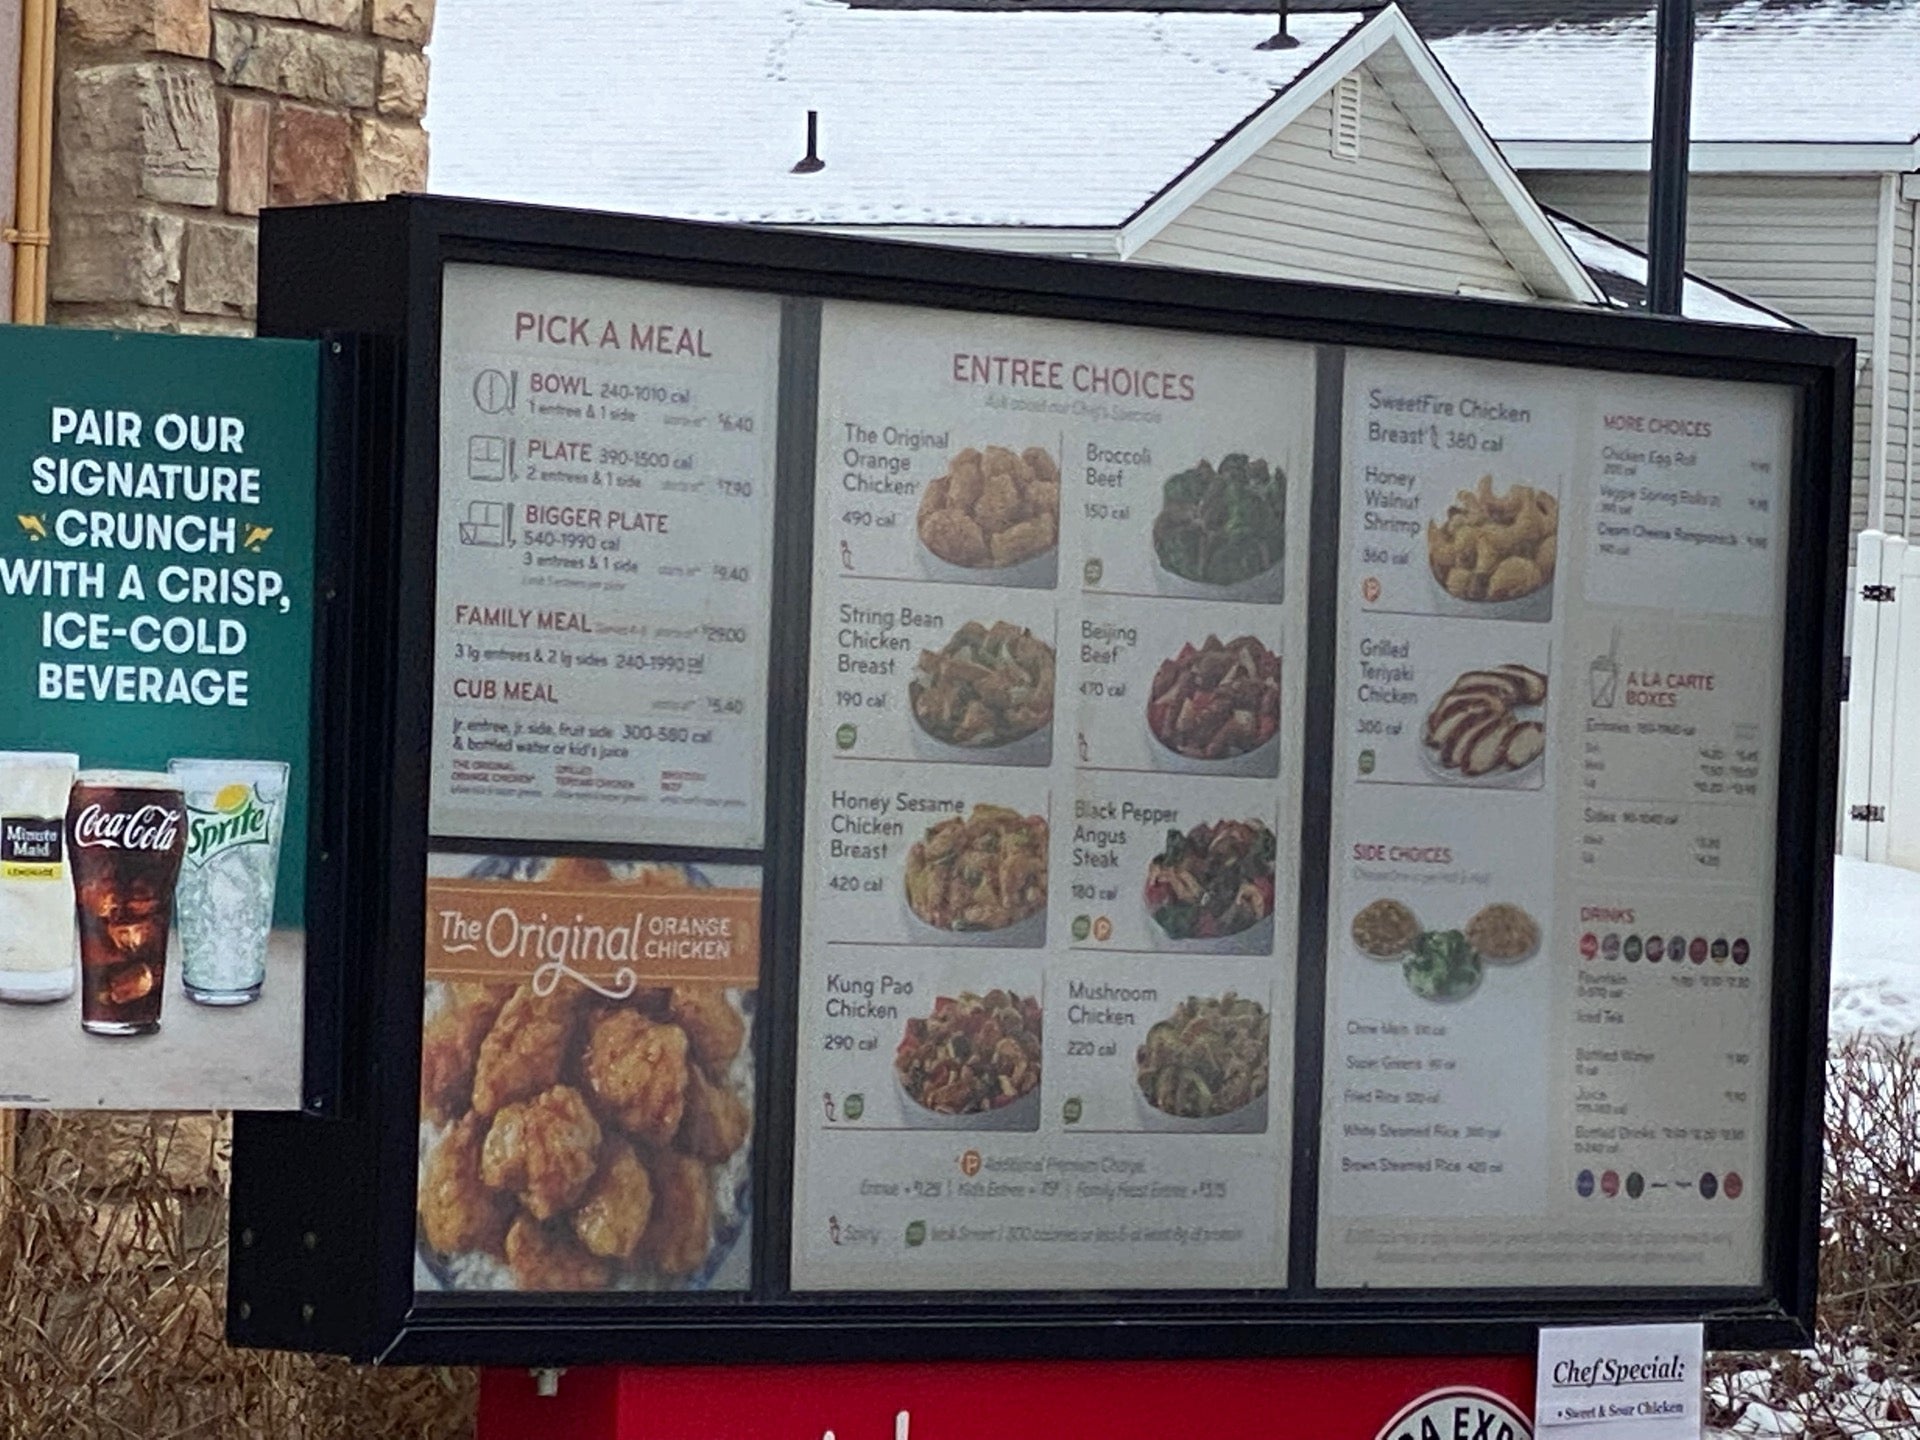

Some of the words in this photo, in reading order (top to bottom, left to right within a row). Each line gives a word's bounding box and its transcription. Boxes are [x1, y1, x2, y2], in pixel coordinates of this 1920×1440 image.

[514, 312, 589, 347] PICK
[600, 320, 620, 350] A
[630, 323, 712, 358] MEAL
[530, 372, 593, 397] BOWL
[600, 382, 667, 403] 240-1010
[671, 389, 690, 404] cal
[953, 353, 1064, 389] ENTREE
[1072, 364, 1195, 401] CHOICES
[601, 405, 606, 419] 1
[1459, 399, 1531, 423] Chicken
[52, 406, 142, 448] PAIR
[154, 413, 245, 454] OUR
[844, 422, 878, 444] The
[883, 426, 949, 450] Original
[1603, 415, 1645, 433] MORE
[1648, 418, 1712, 438] CHOICES
[528, 439, 593, 462] PLATE
[673, 454, 693, 470] cal
[1086, 443, 1152, 465] Broccoli
[1481, 436, 1504, 452] cal
[843, 448, 911, 475] Orange
[32, 456, 260, 505] SIGNATURE
[526, 465, 536, 481] 2
[592, 471, 602, 485] &
[607, 471, 612, 486] 1
[1086, 467, 1123, 488] Beef
[1365, 466, 1417, 489] Honey
[525, 504, 600, 529] BIGGER
[607, 510, 669, 534] PLATE
[841, 511, 872, 526] 490
[876, 513, 896, 527] cal
[1085, 503, 1108, 519] 150
[1111, 506, 1130, 520] cal
[55, 509, 237, 554] CRUNCH
[1364, 512, 1422, 538] Shrimp
[522, 530, 596, 550] 540-1990
[600, 535, 621, 551] cal
[522, 551, 533, 567] 3
[588, 554, 598, 570] &
[603, 555, 608, 570] 1
[0, 557, 105, 598] WITH
[118, 565, 146, 600] A
[157, 566, 291, 614] CRISP,
[455, 604, 532, 630] FAMILY
[537, 610, 592, 634] MEAL
[840, 603, 895, 631] String
[900, 607, 944, 629] Bean
[42, 611, 248, 656] ICE-COLD
[838, 628, 911, 651] Chicken
[1081, 620, 1137, 647] Beijing
[454, 642, 464, 659] 3
[547, 649, 557, 664] 2
[1080, 644, 1119, 664] Beef
[1359, 638, 1411, 659] Grilled
[838, 653, 896, 675] Breast
[38, 662, 249, 707] BEVERAGE
[453, 678, 497, 700] CUB
[503, 680, 559, 705] MEAL
[1666, 673, 1716, 691] CARTE
[836, 691, 862, 707] 190
[866, 693, 886, 708] cal
[1358, 684, 1418, 705] Chicken
[831, 790, 891, 816] Honey
[896, 792, 965, 814] Sesame
[1074, 799, 1117, 820] Black
[1122, 801, 1179, 826] Pepper
[74, 803, 181, 851] Coca-Cola
[188, 803, 266, 855] Sprite
[831, 814, 904, 836] Chicken
[1073, 824, 1127, 848] Angus
[13, 841, 50, 857] Maid
[830, 839, 888, 860] Breast
[1072, 848, 1119, 869] Steak
[829, 875, 860, 892] 420
[863, 877, 883, 892] cal
[648, 916, 732, 938] ORANGE
[439, 910, 482, 942] The
[485, 907, 644, 1000] Original
[644, 939, 732, 960] CHICKEN
[826, 973, 875, 998] Kung
[880, 975, 914, 996] Pao
[1068, 980, 1158, 1001] Mushroom
[826, 997, 898, 1019] Chicken
[1067, 1004, 1135, 1026] Chicken
[824, 1034, 854, 1050] 290
[858, 1036, 878, 1051] cal
[1098, 1040, 1117, 1056] cal
[1553, 1358, 1603, 1388] Chef
[1602, 1354, 1686, 1387] Special:
[1638, 1401, 1684, 1416] Chicken
